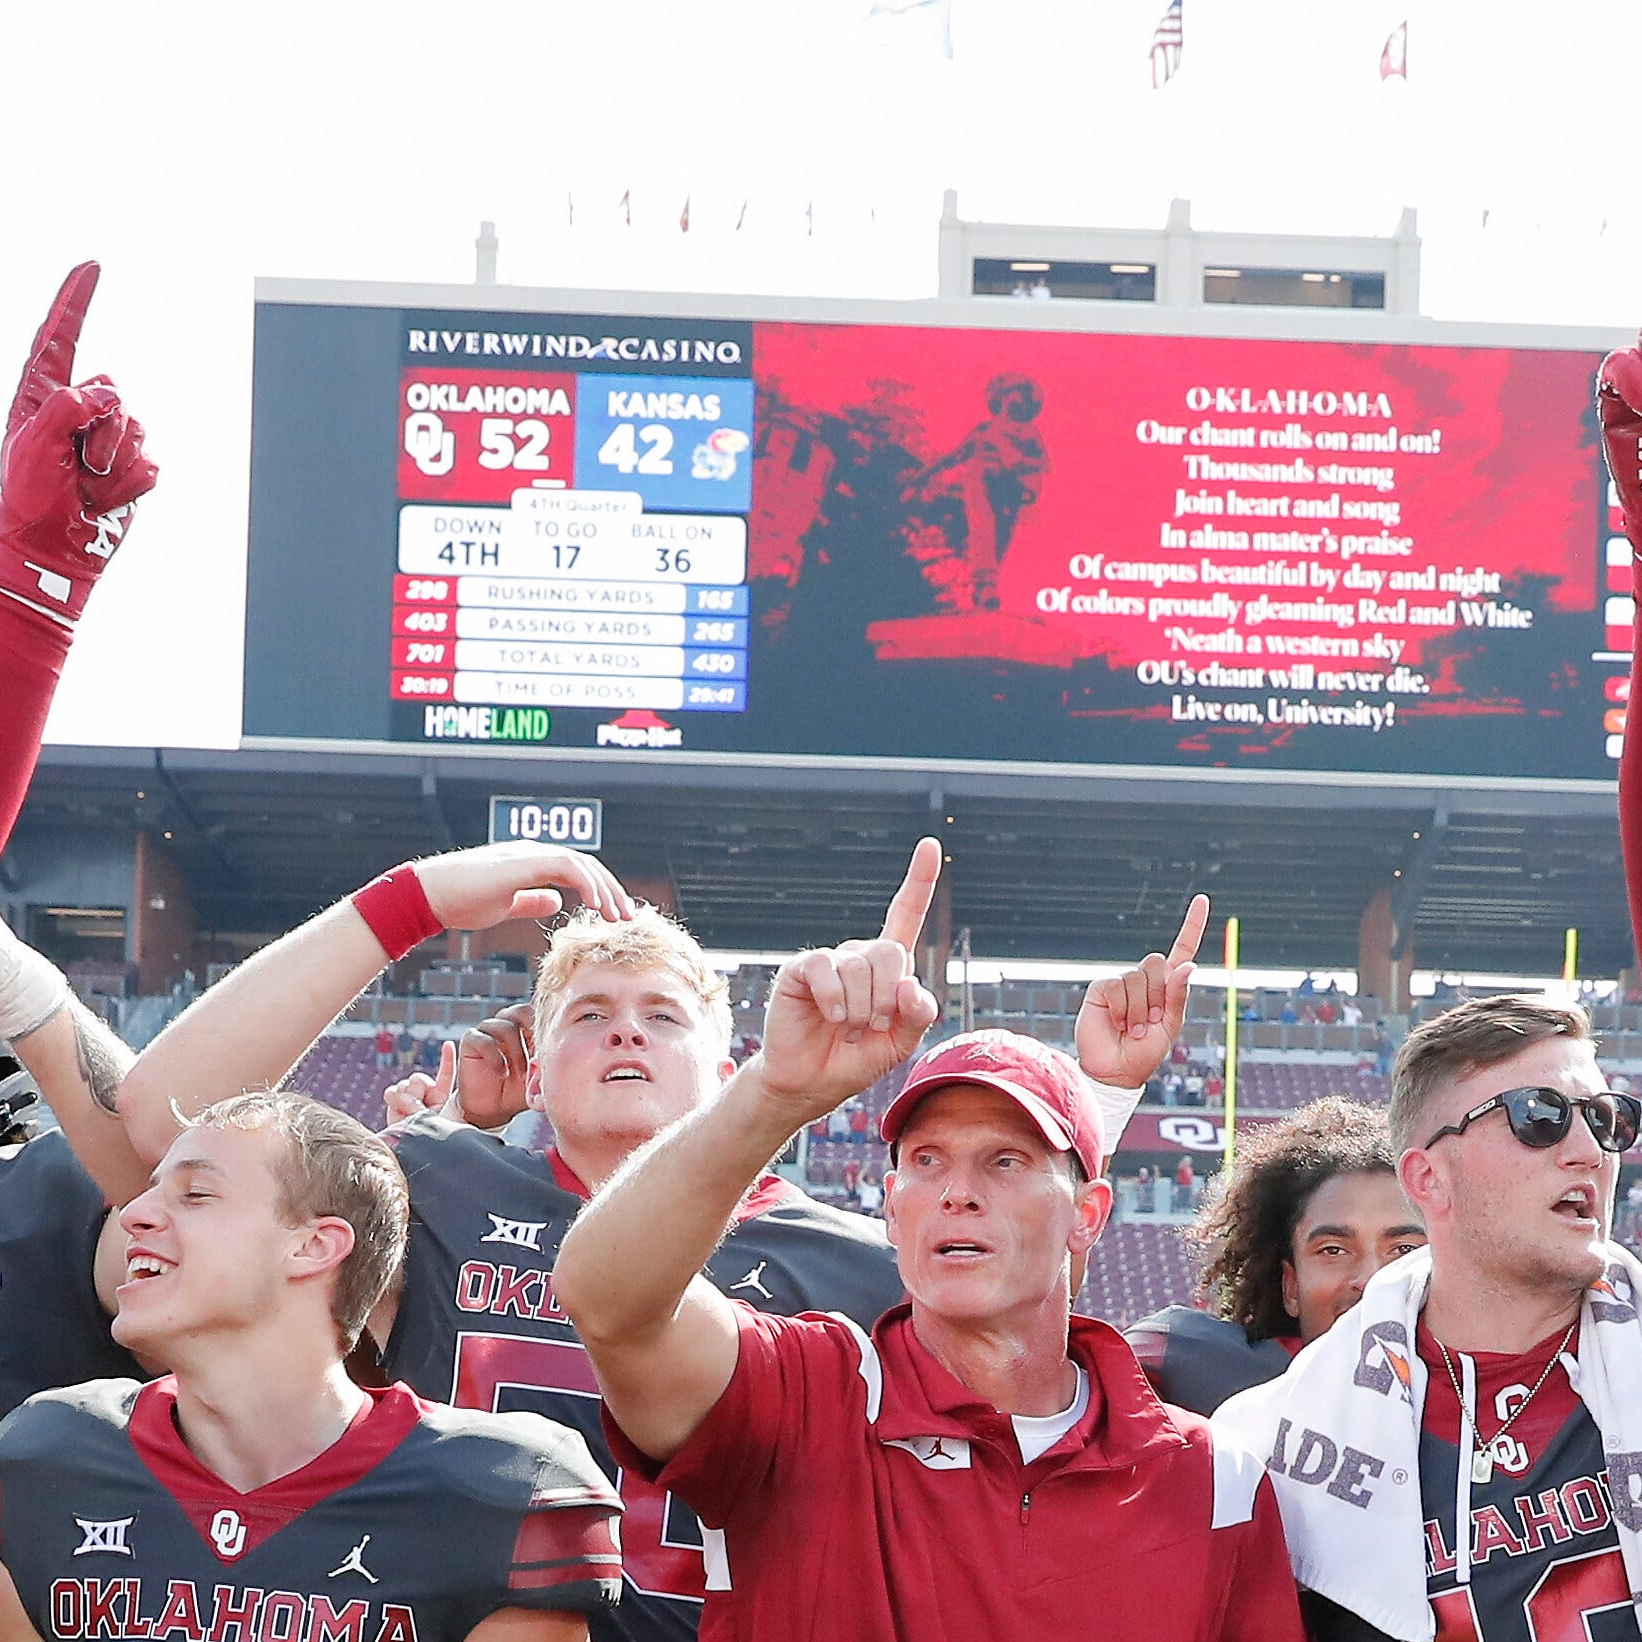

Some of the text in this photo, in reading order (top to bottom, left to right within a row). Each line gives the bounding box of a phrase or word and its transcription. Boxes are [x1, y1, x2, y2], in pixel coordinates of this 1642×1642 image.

[408, 330, 741, 364] RIVERWIND CASINO
[407, 382, 571, 415] OKLAHOMA
[608, 391, 721, 420] KANSAS
[478, 418, 551, 471] 52
[598, 423, 674, 475] 42
[1136, 419, 1441, 454] Our chant rolls on and on!
[1183, 454, 1394, 492] Thousands strong
[1174, 489, 1401, 526] Join heart and song
[434, 518, 502, 535] DOWN
[534, 521, 597, 538] TO GO
[631, 524, 713, 540] BALL ON
[1160, 523, 1413, 559] In alma mater's praise
[437, 541, 500, 567] 4TH
[552, 545, 581, 569] 17
[655, 548, 692, 573] 36
[1069, 554, 1502, 597] Of campus beautiful by day and night
[488, 584, 579, 602] RUSHING
[587, 587, 655, 605] YARDS
[1036, 587, 1534, 629] Of colors proudly gleaming Red and White
[488, 617, 576, 634] PASSING
[584, 620, 652, 637] YARDS
[405, 643, 446, 664] 701
[498, 648, 563, 665] TOTAL
[570, 651, 641, 668] YARDS
[1245, 636, 1262, 655] a
[1264, 634, 1360, 658] western
[1361, 633, 1406, 664] sky
[494, 680, 541, 697] TIME
[549, 682, 573, 698] OF
[583, 684, 637, 700] POSS
[1136, 660, 1431, 695] OU's chant will never die.
[424, 705, 551, 741] HOMELAND
[1171, 694, 1396, 732] Live on, University!
[509, 805, 594, 840] 10:00
[210, 1508, 247, 1558] OU
